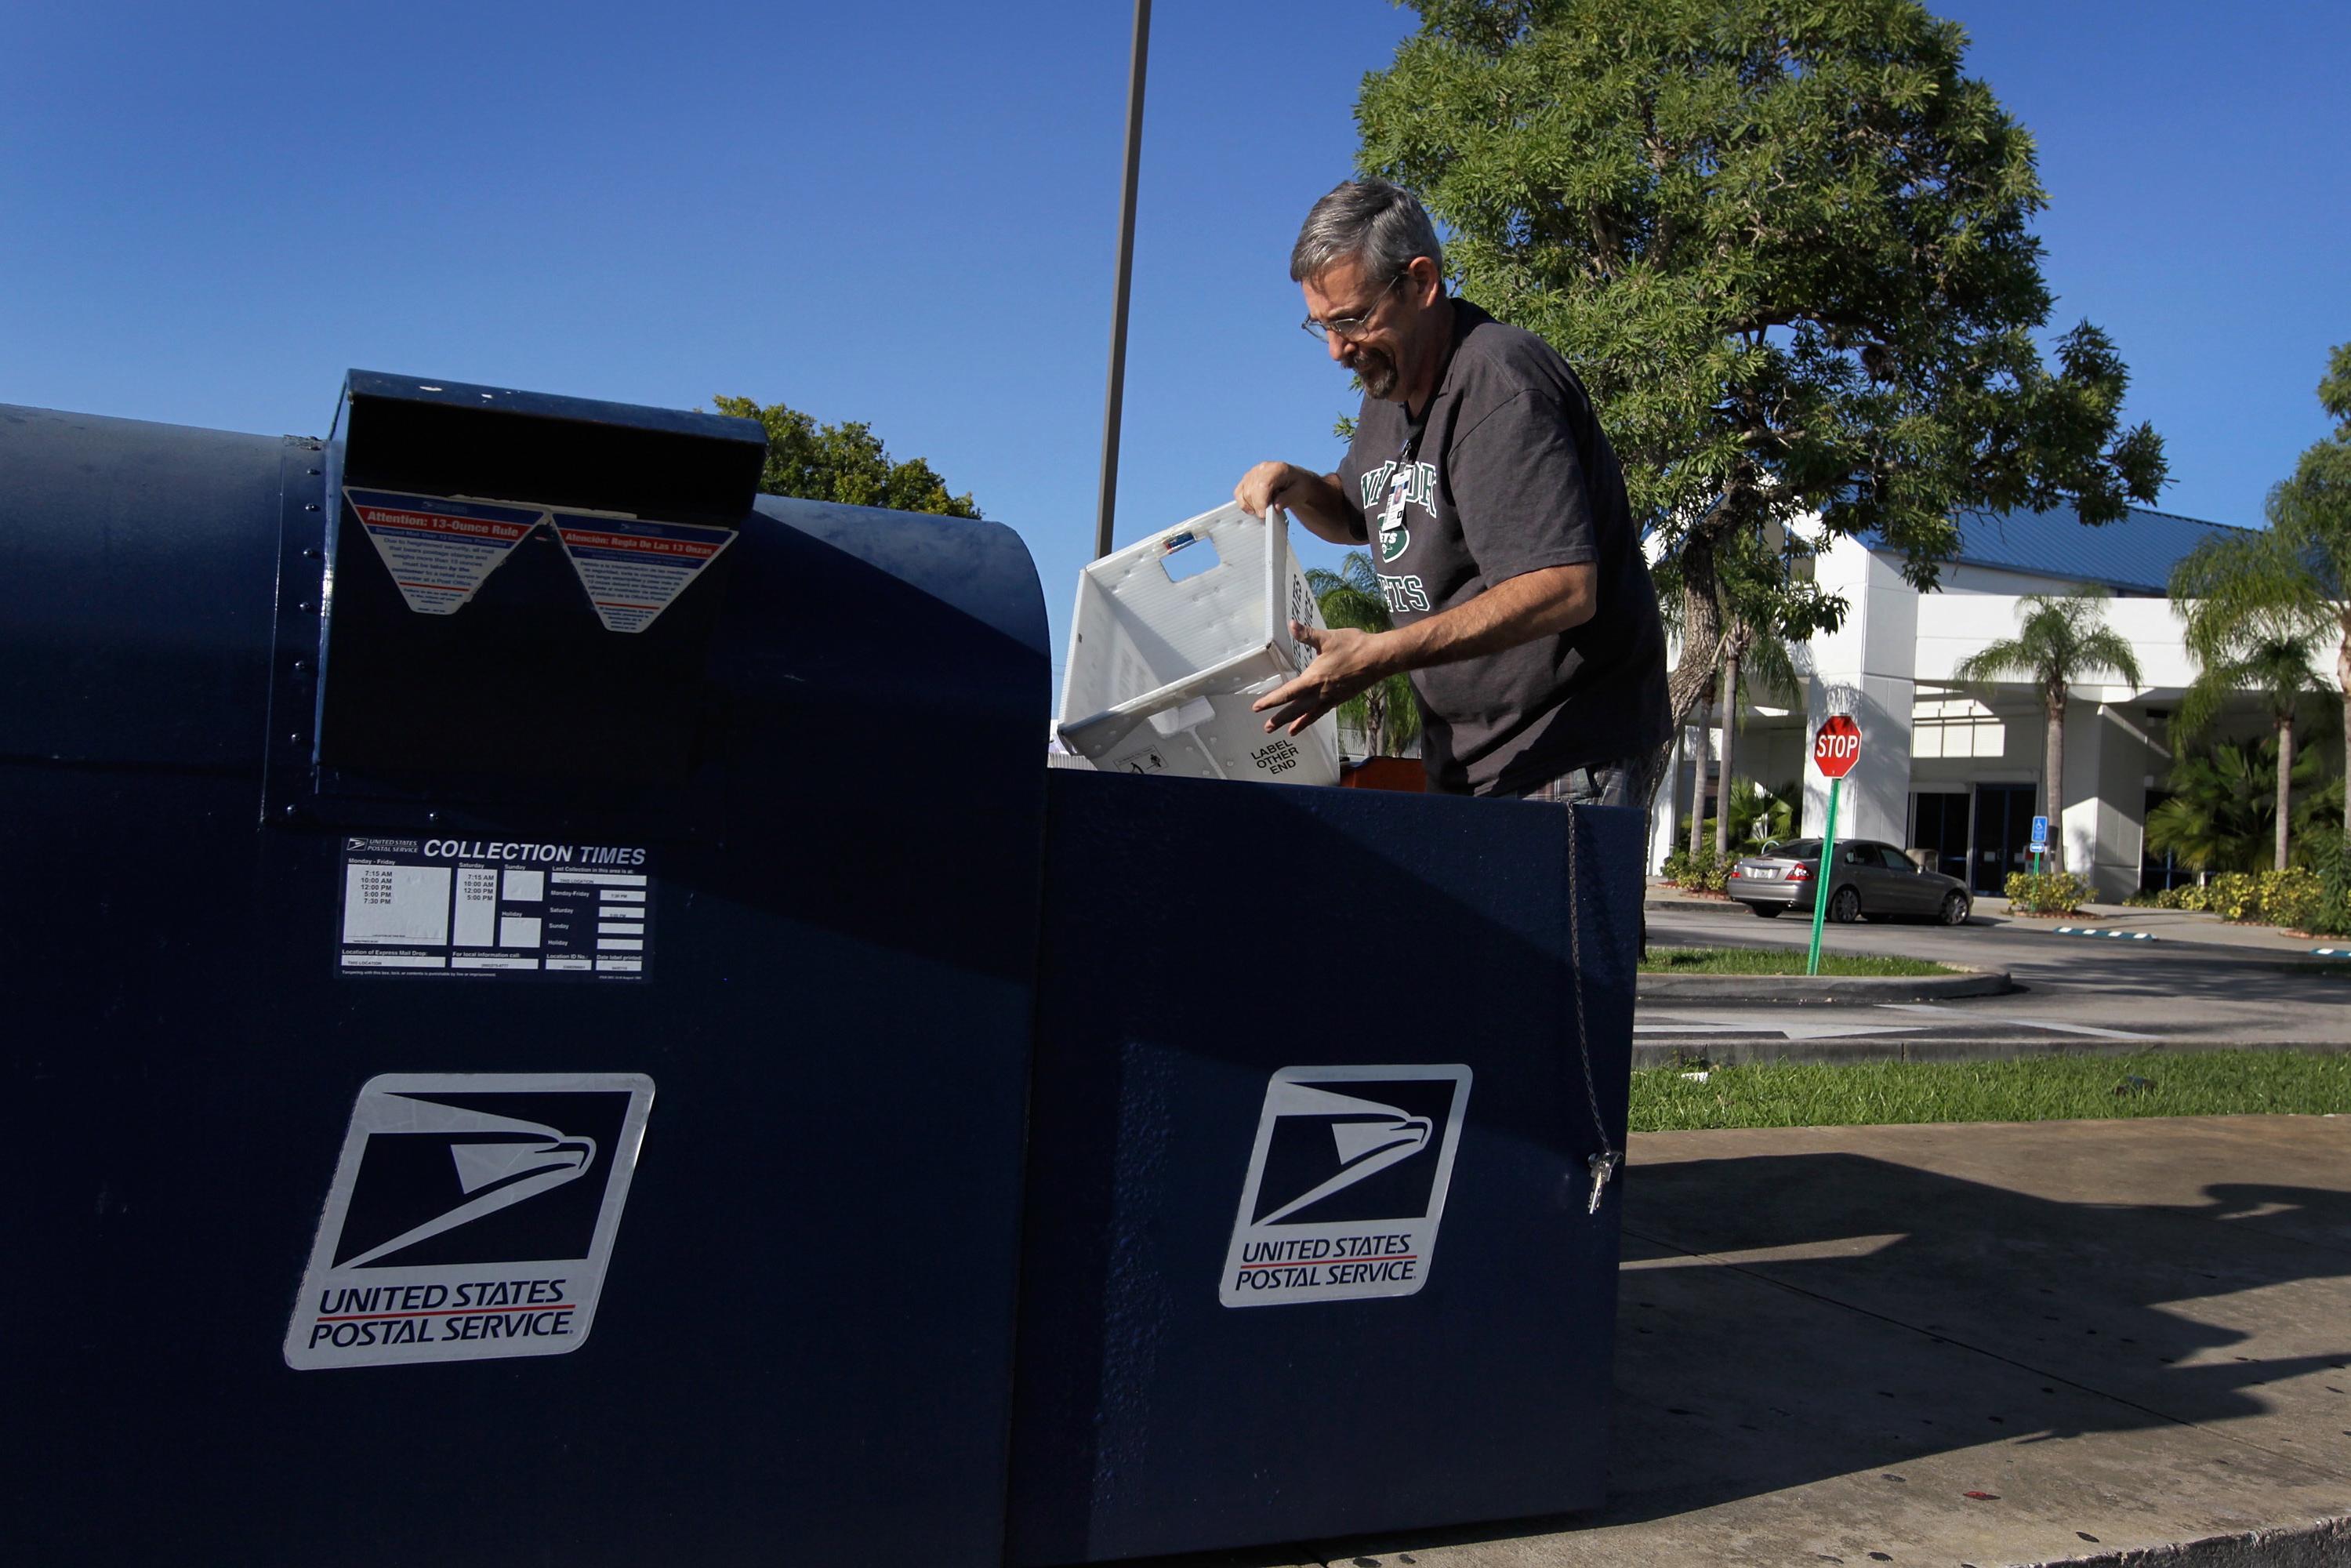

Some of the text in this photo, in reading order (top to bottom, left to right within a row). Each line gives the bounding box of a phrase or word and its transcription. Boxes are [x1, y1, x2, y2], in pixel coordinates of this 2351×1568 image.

[367, 510, 517, 536] Attention: 13-Ounce Rule
[566, 532, 712, 555] Atención: Regla De Las 13 Onzas
[1291, 573, 1302, 622] TATES
[1250, 739, 1293, 760] LABEL
[1256, 746, 1299, 768] OTHER
[1816, 735, 1858, 758] STOP
[1269, 759, 1296, 775] END
[424, 839, 647, 866] COLLECTION TIMES
[1243, 1234, 1411, 1263] UNITED STATES
[1235, 1261, 1417, 1290] POSTAL SERVICE
[320, 1279, 566, 1314] UNITED STATES
[309, 1311, 573, 1348] POSTAL SERVICE
